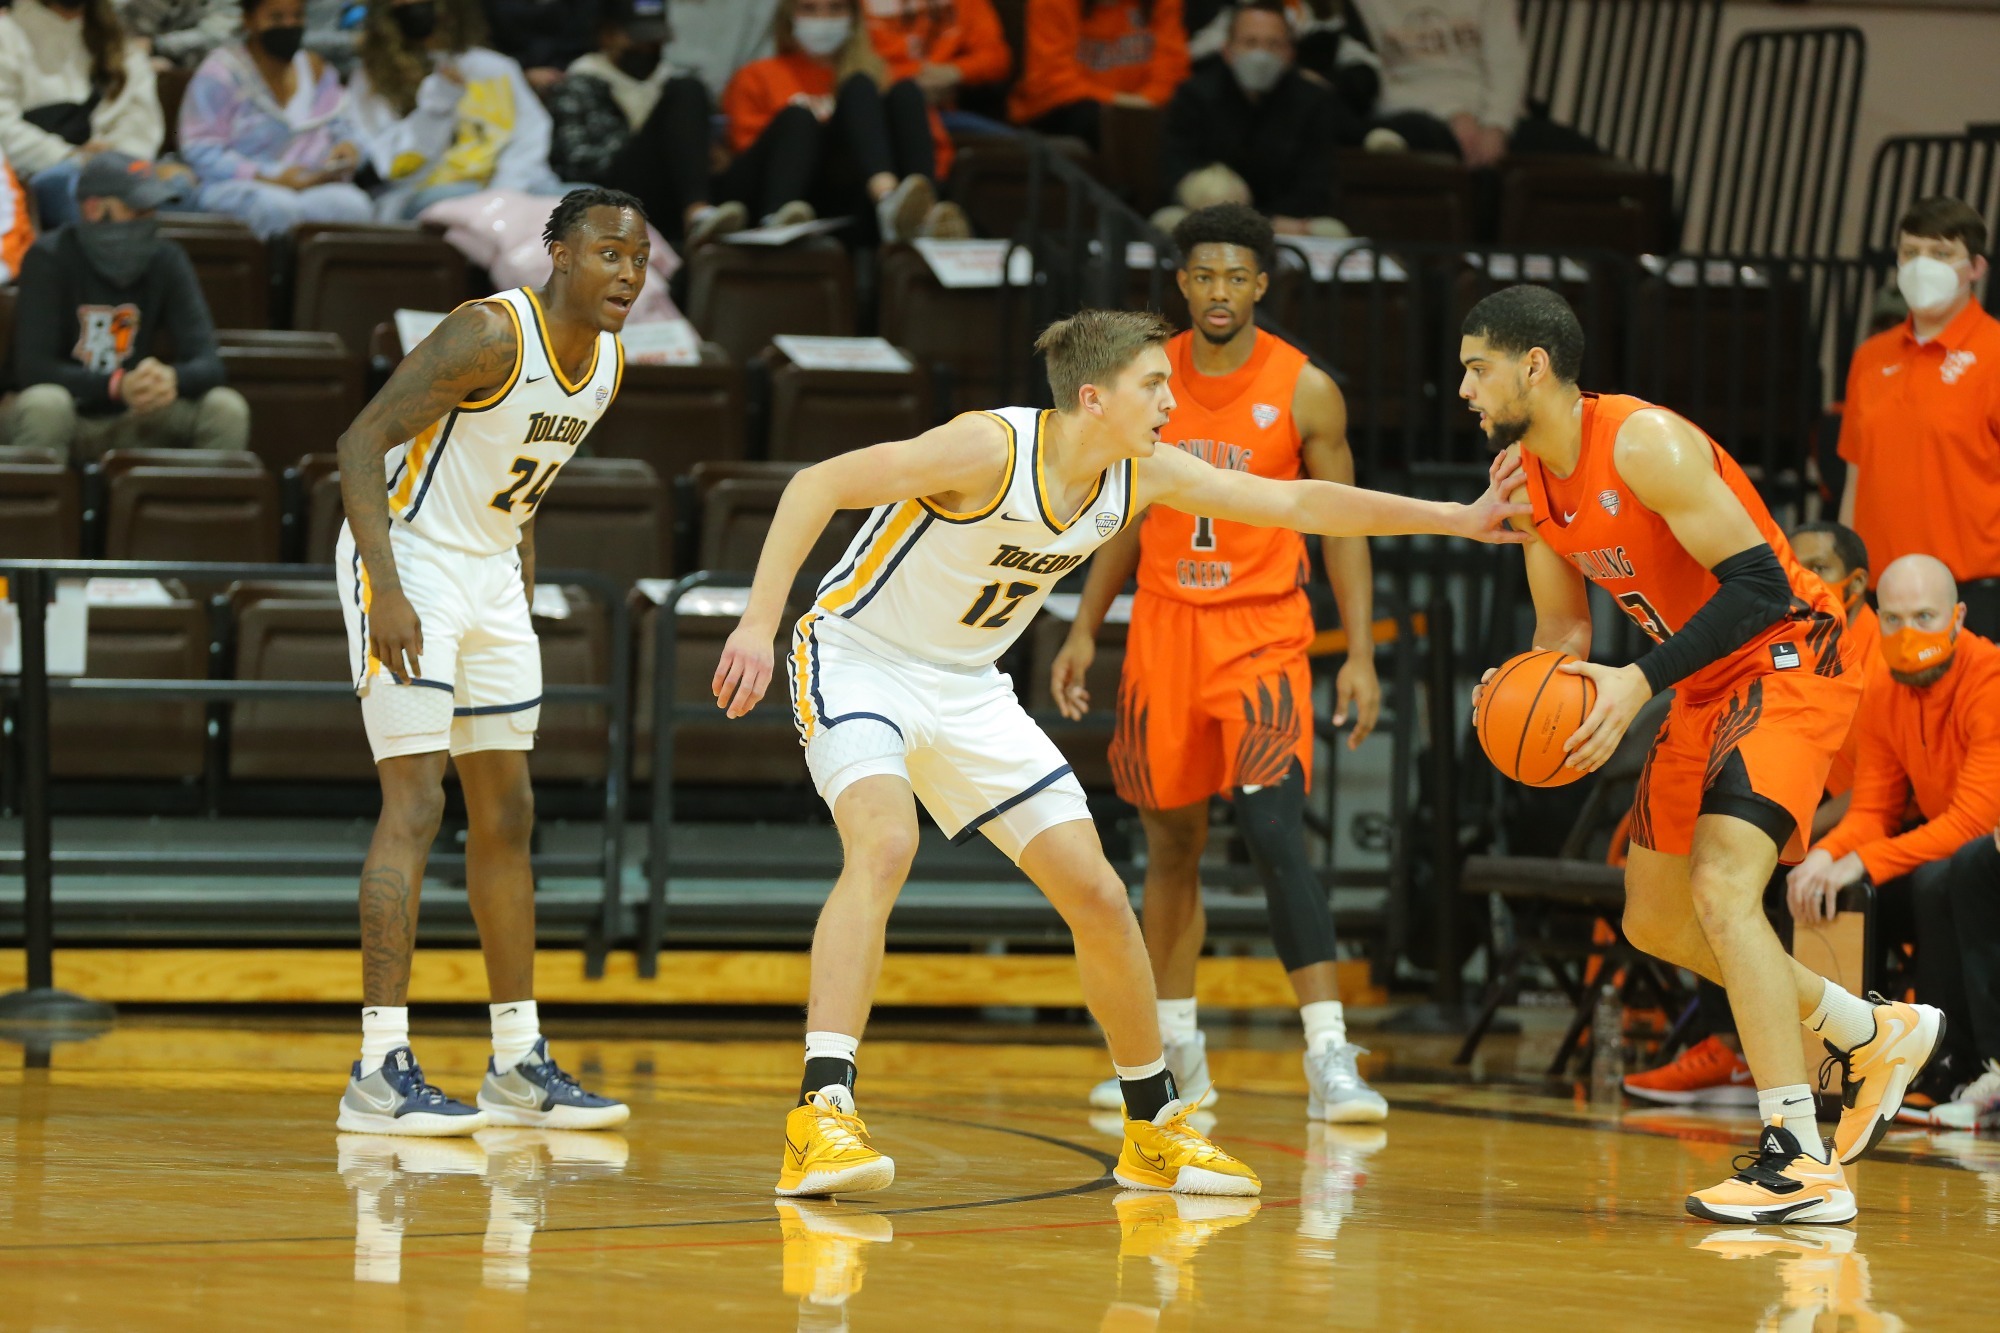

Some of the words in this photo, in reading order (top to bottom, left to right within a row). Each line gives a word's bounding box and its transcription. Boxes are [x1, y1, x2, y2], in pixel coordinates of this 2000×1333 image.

[523, 411, 588, 446] TOLEDO
[488, 454, 562, 514] 24
[1191, 515, 1216, 551] 1
[989, 543, 1083, 575] TOLEDO
[1176, 557, 1232, 589] GREEN
[957, 578, 1041, 630] 12
[1779, 645, 1789, 653] L
